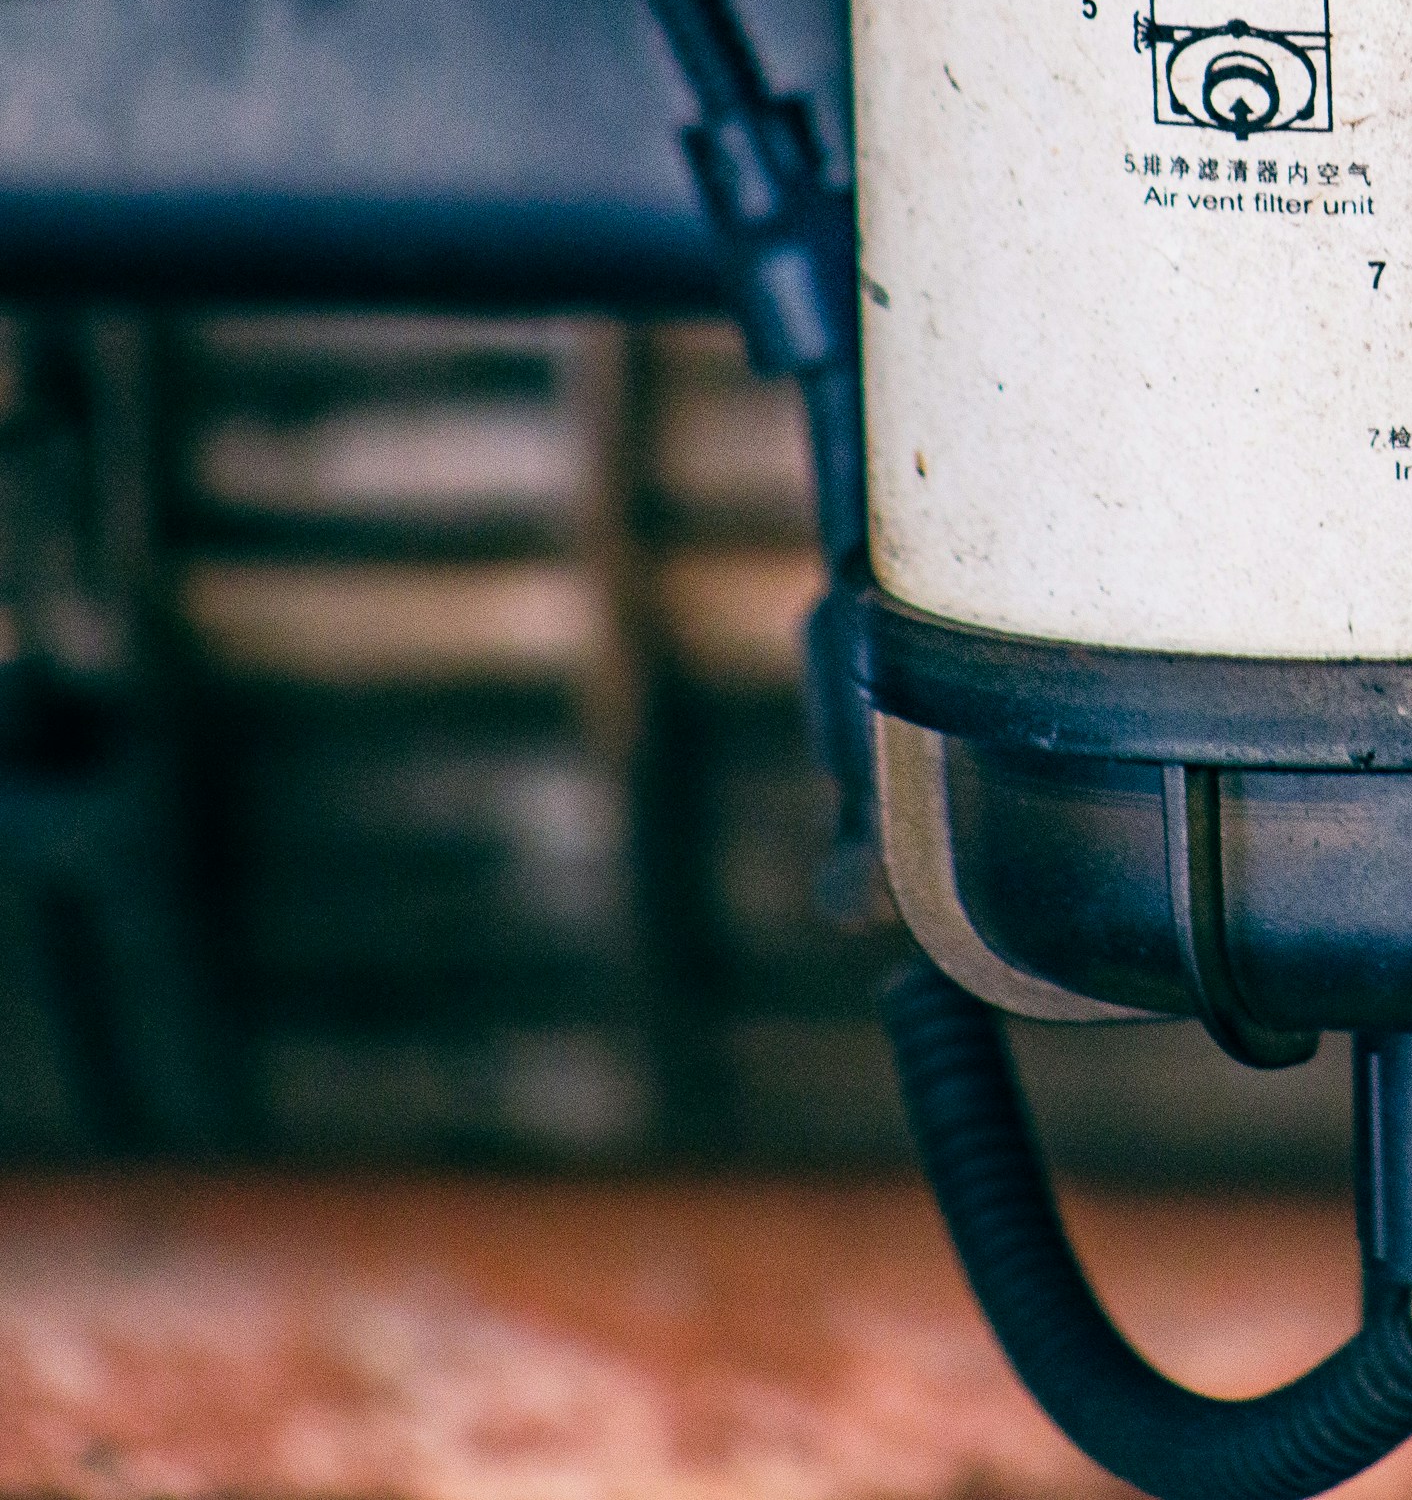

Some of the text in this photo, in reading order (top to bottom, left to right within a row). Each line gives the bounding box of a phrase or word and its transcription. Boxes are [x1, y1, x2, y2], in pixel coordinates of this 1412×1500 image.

[1145, 187, 1374, 216] Air vent filter unit
[1368, 261, 1386, 289] 7
